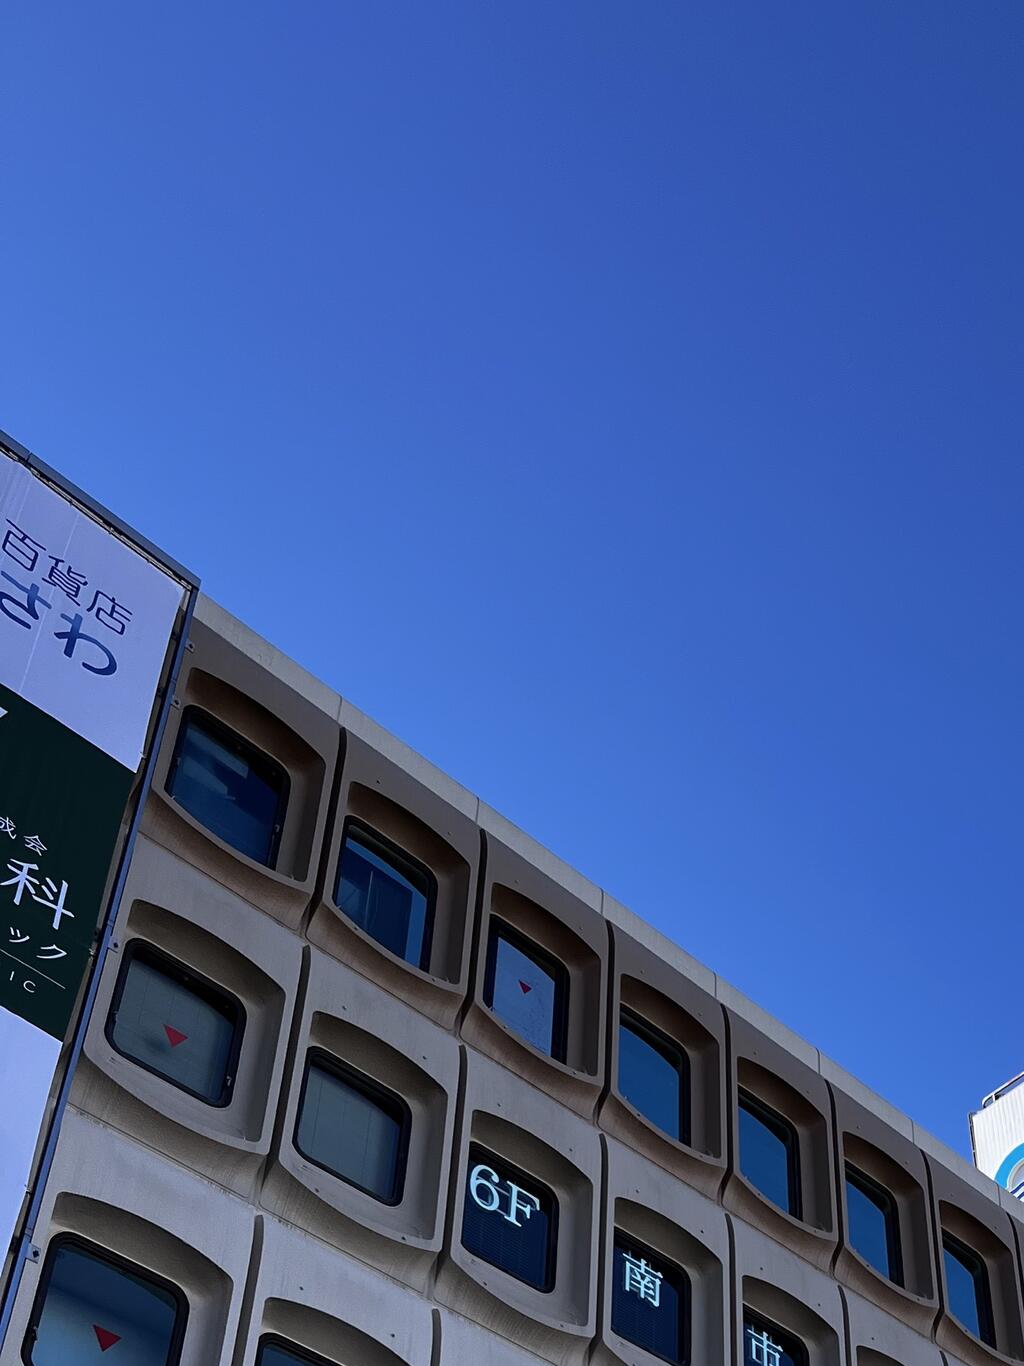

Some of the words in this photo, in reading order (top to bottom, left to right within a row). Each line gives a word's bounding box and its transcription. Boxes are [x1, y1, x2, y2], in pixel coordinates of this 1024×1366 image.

[1, 518, 133, 635] 百貨店
[0, 570, 117, 676] さわ
[0, 858, 75, 930] 科
[469, 1164, 541, 1228] 6F
